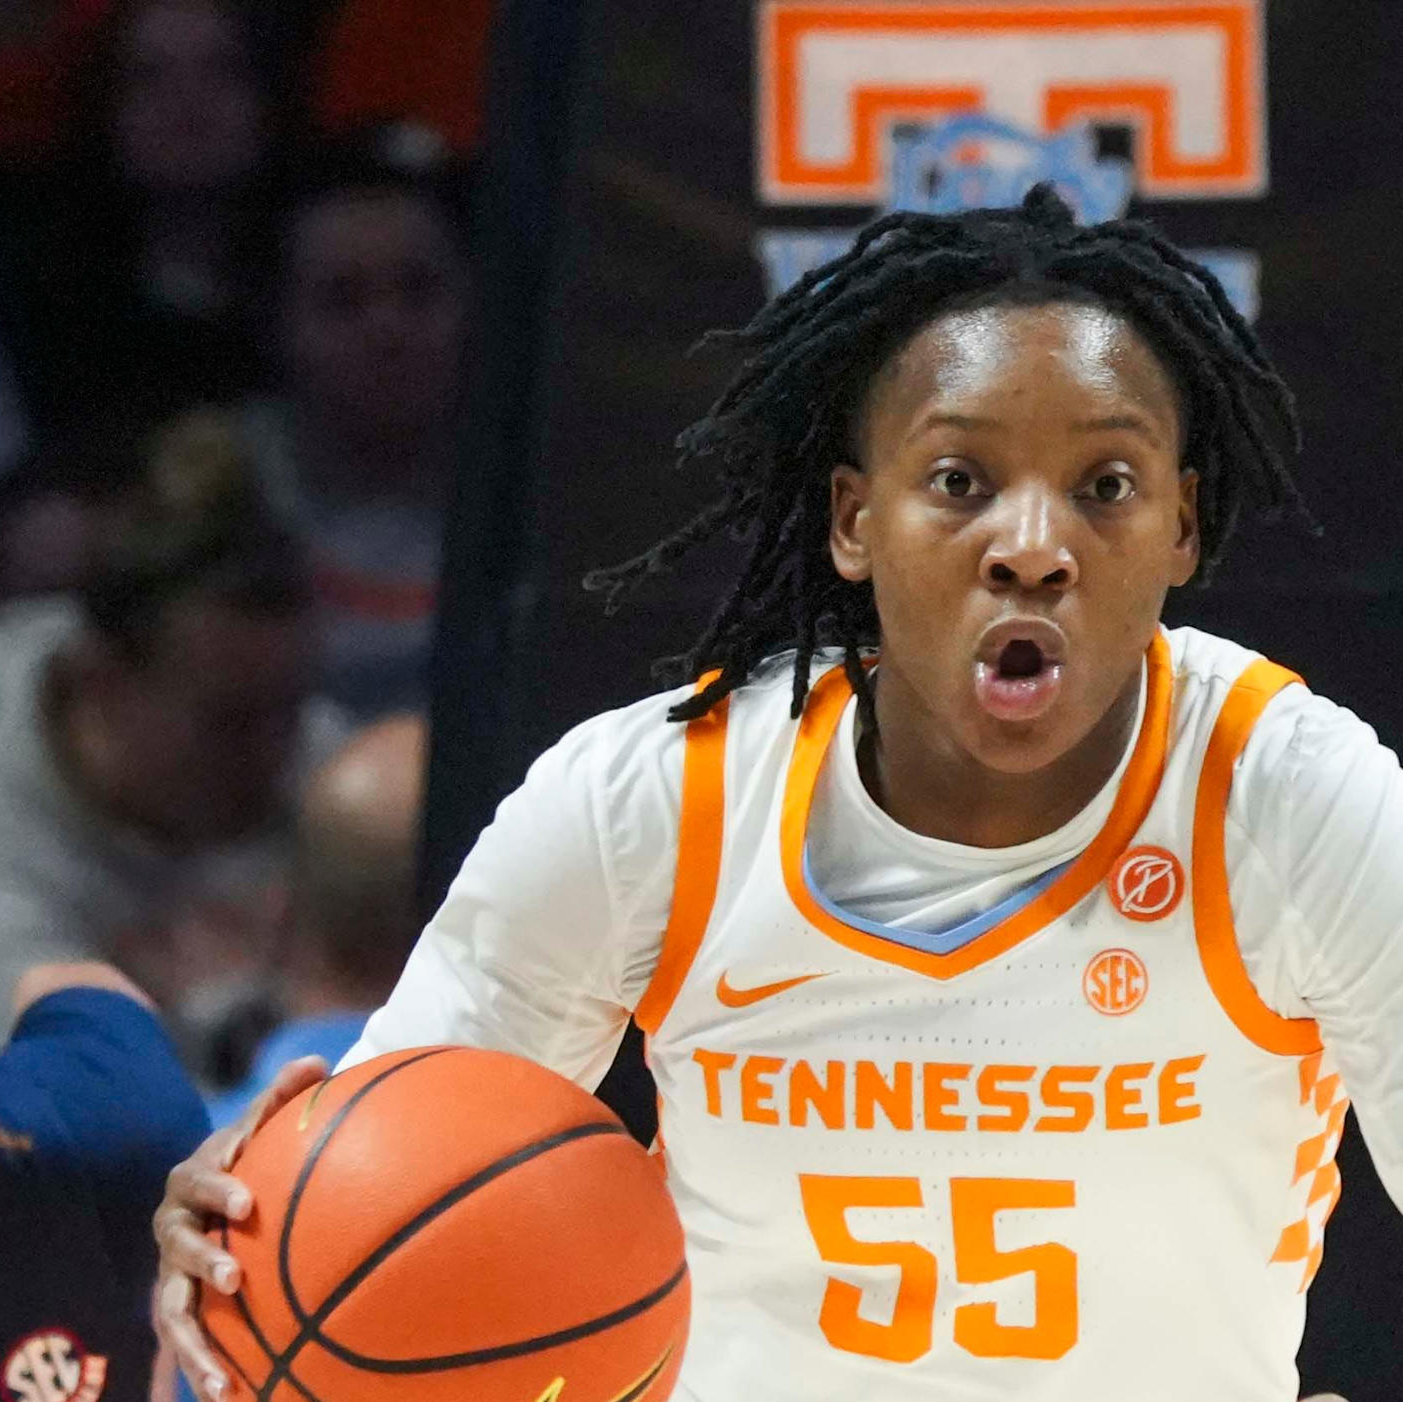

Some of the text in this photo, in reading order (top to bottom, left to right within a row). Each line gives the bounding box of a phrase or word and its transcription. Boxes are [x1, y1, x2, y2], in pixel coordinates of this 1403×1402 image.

[1087, 953, 1145, 1011] SEC
[693, 1046, 1207, 1134] TENNESSEE
[798, 1172, 1079, 1364] 55
